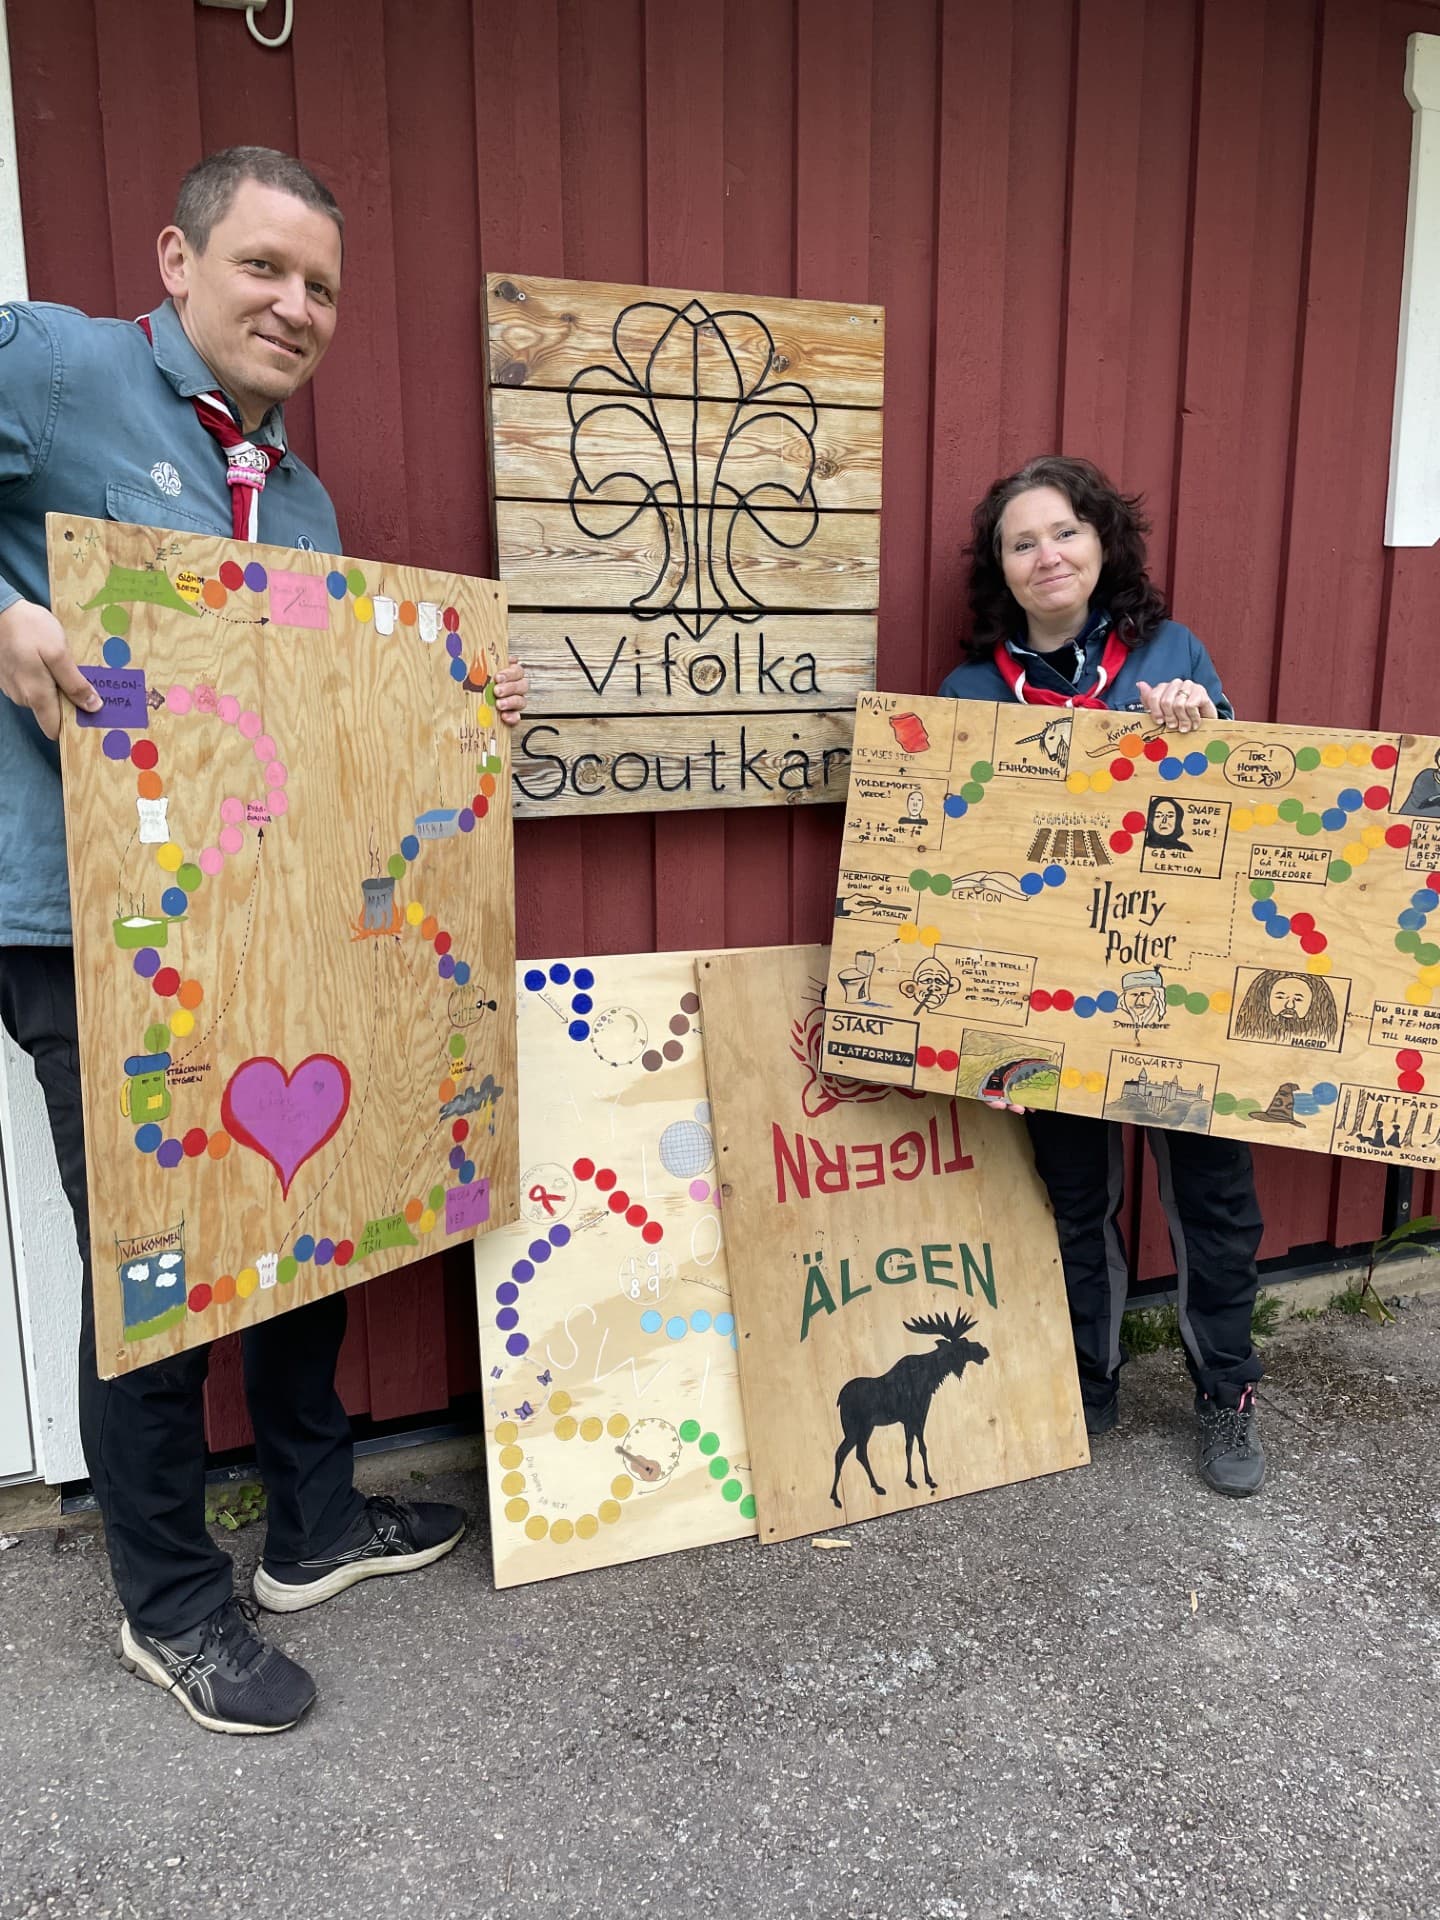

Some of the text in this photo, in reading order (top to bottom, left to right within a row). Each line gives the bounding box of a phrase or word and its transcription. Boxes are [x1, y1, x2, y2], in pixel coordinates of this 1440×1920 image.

[564, 631, 822, 697] Vifolka
[511, 725, 850, 800] Scoutkår
[998, 757, 1061, 778] ENHÖRNING
[1187, 803, 1222, 817] SNAPE
[1254, 847, 1269, 858] DU
[1275, 846, 1293, 860] FÅR
[843, 872, 891, 883] HERMIONE
[1154, 862, 1202, 875] LEKTION
[1253, 868, 1313, 880] DUMBLEDORE
[951, 887, 1001, 903] LEKTION
[1086, 880, 1166, 934] Harry
[1104, 929, 1177, 967] Potter
[1395, 1006, 1419, 1018] BLIR
[831, 1014, 894, 1036] START
[1291, 1037, 1327, 1049] HAGRID
[1404, 1033, 1438, 1045] HAGRID
[831, 1044, 894, 1062] PLATFORM
[1121, 1055, 1184, 1069] HOGWARTS
[1366, 1091, 1439, 1111] NATTFÄRD
[772, 1097, 975, 1204] TIGERN
[121, 1231, 181, 1259] VÄLKOMMEN
[800, 1242, 998, 1342] ÄLGEN
